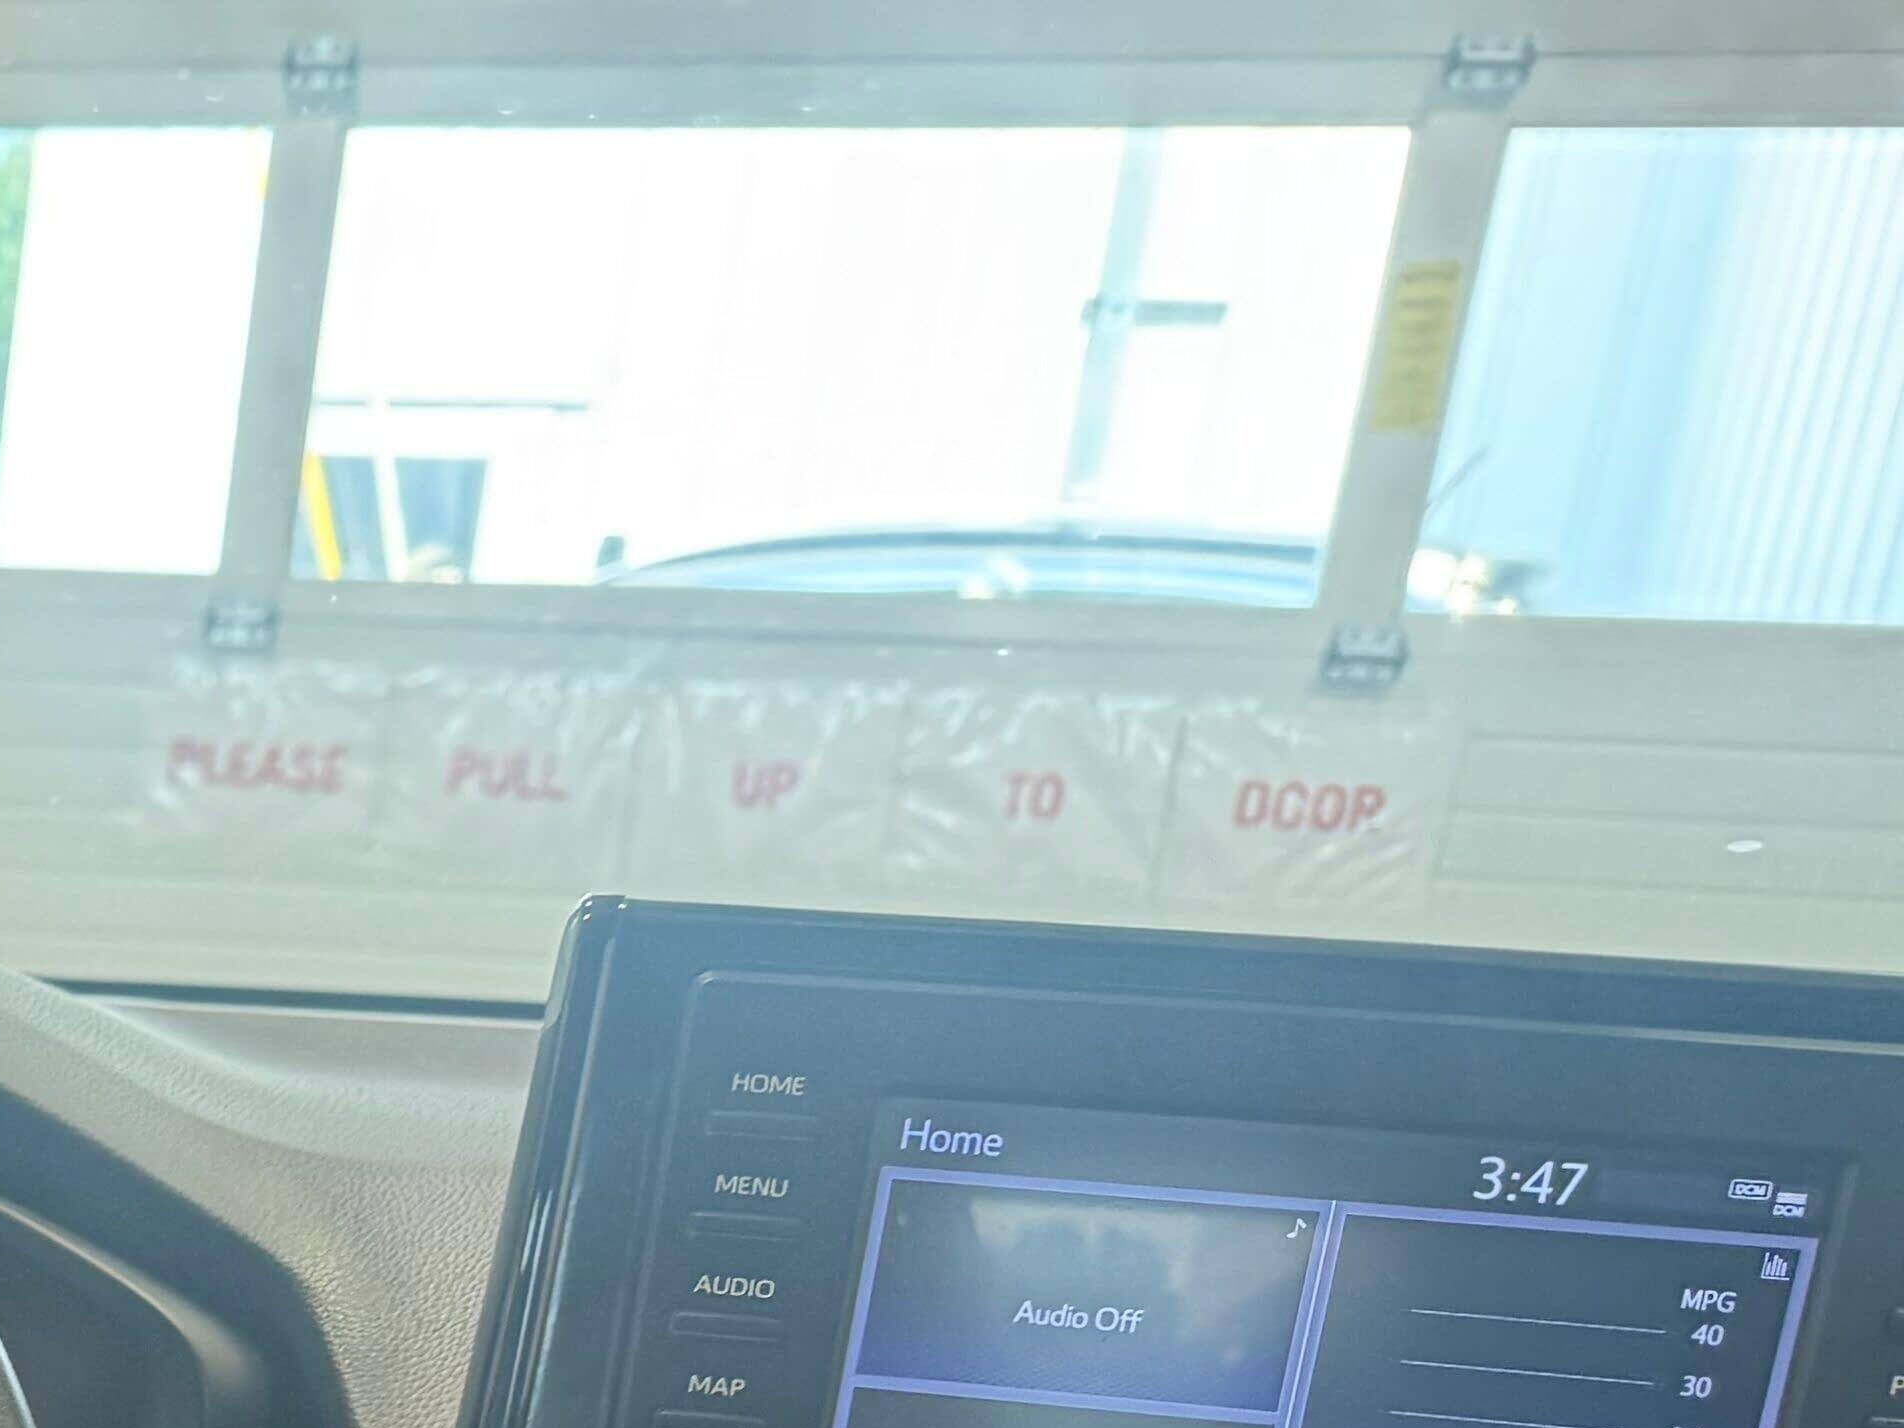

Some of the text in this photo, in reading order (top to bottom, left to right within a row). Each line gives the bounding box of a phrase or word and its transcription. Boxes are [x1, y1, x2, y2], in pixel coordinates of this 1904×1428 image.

[166, 737, 348, 794] PLEASE
[444, 745, 572, 801] PULL
[731, 759, 801, 808] UP
[1003, 770, 1065, 822] TO
[731, 1073, 806, 1096] HOME
[899, 1118, 1004, 1158] Home
[715, 1174, 789, 1198] MENU
[1473, 1156, 1588, 1206] 3:47
[693, 1275, 776, 1299] AUDIO
[1680, 1289, 1736, 1314] MPG
[1013, 1301, 1144, 1333] Audio Off
[1691, 1325, 1724, 1347] 40
[687, 1374, 745, 1397] MAP
[1679, 1376, 1712, 1398] 30
